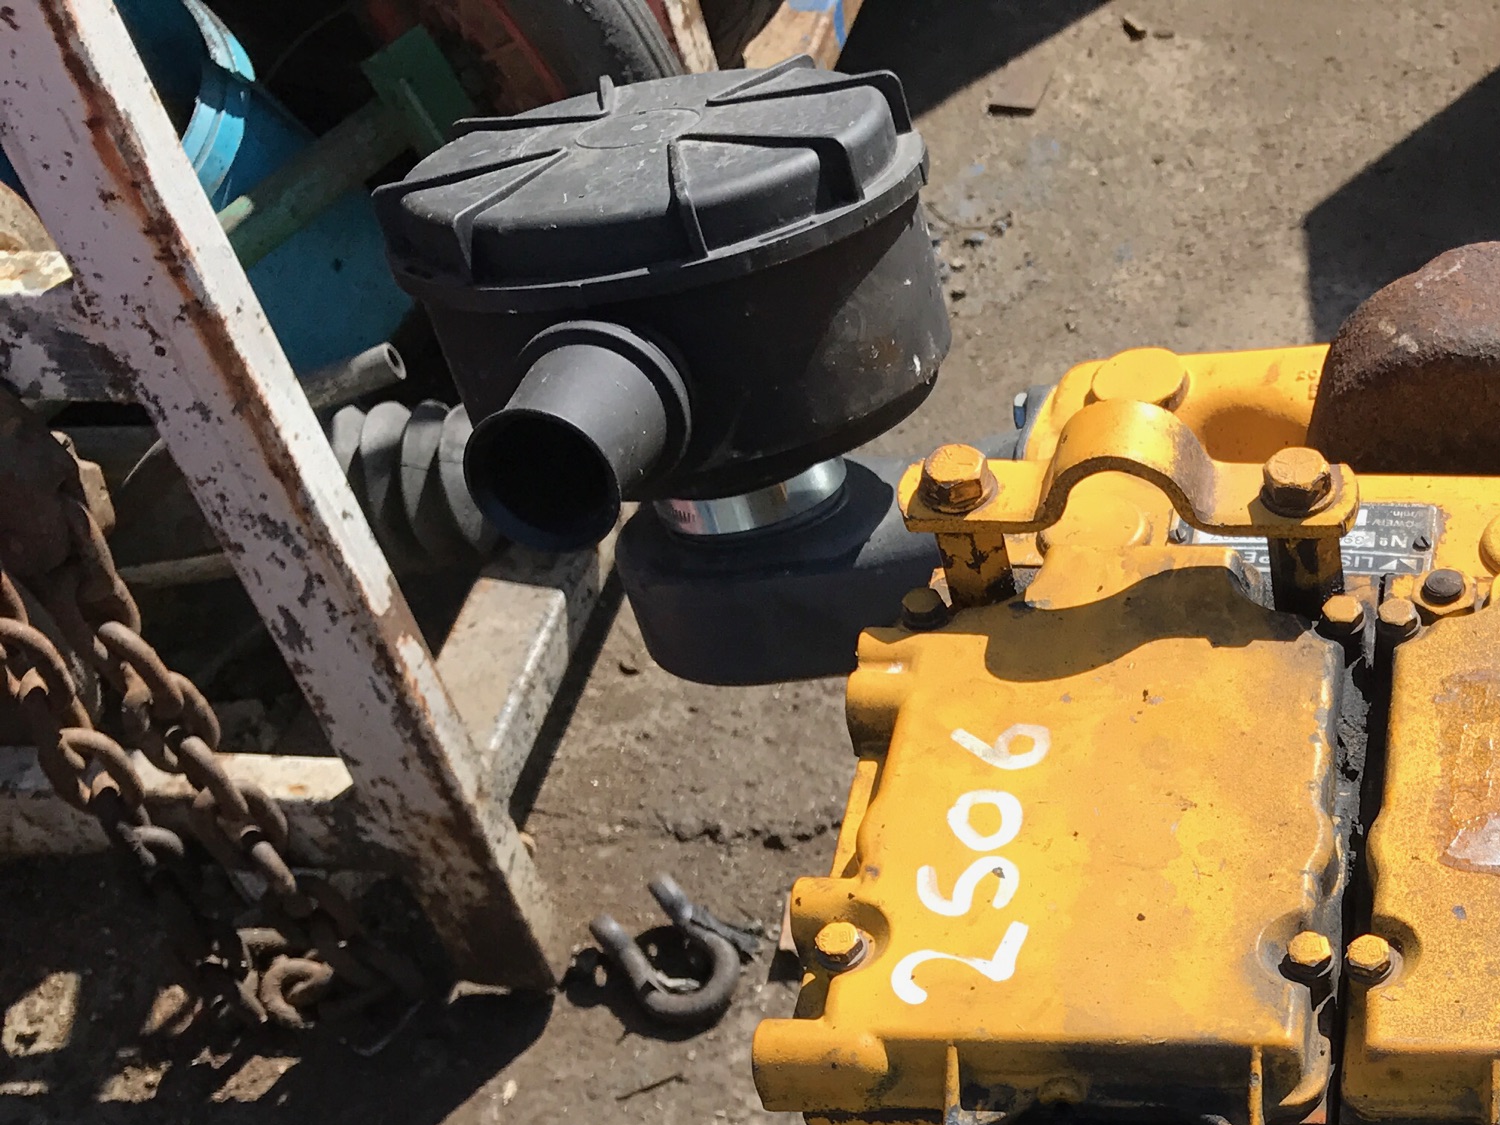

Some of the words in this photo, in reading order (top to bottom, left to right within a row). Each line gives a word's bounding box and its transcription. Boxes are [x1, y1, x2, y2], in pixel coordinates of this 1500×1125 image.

[1242, 551, 1271, 565] PE
[1340, 554, 1375, 569] LIS
[891, 723, 1050, 1005] 2506
